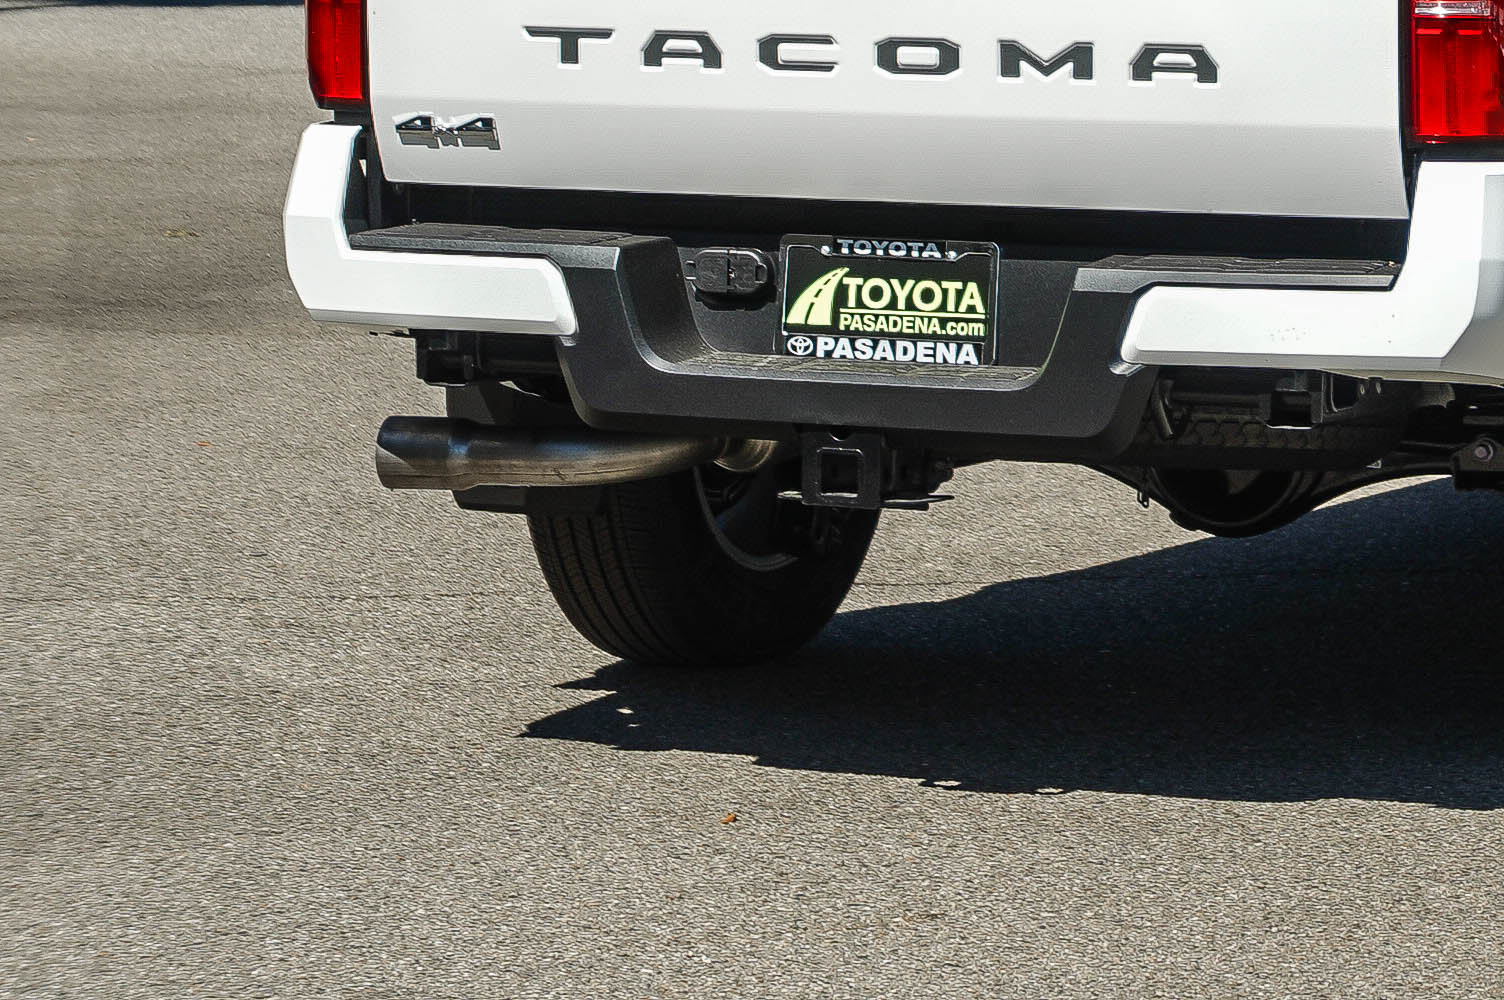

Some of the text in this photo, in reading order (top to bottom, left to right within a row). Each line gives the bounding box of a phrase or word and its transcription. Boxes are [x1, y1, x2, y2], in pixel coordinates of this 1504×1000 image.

[521, 25, 1220, 83] TACOMA
[837, 238, 942, 259] TOYOTA
[842, 276, 986, 313] TOYOTA
[839, 313, 986, 337] PASADENA.com
[816, 336, 979, 366] PASADENA
